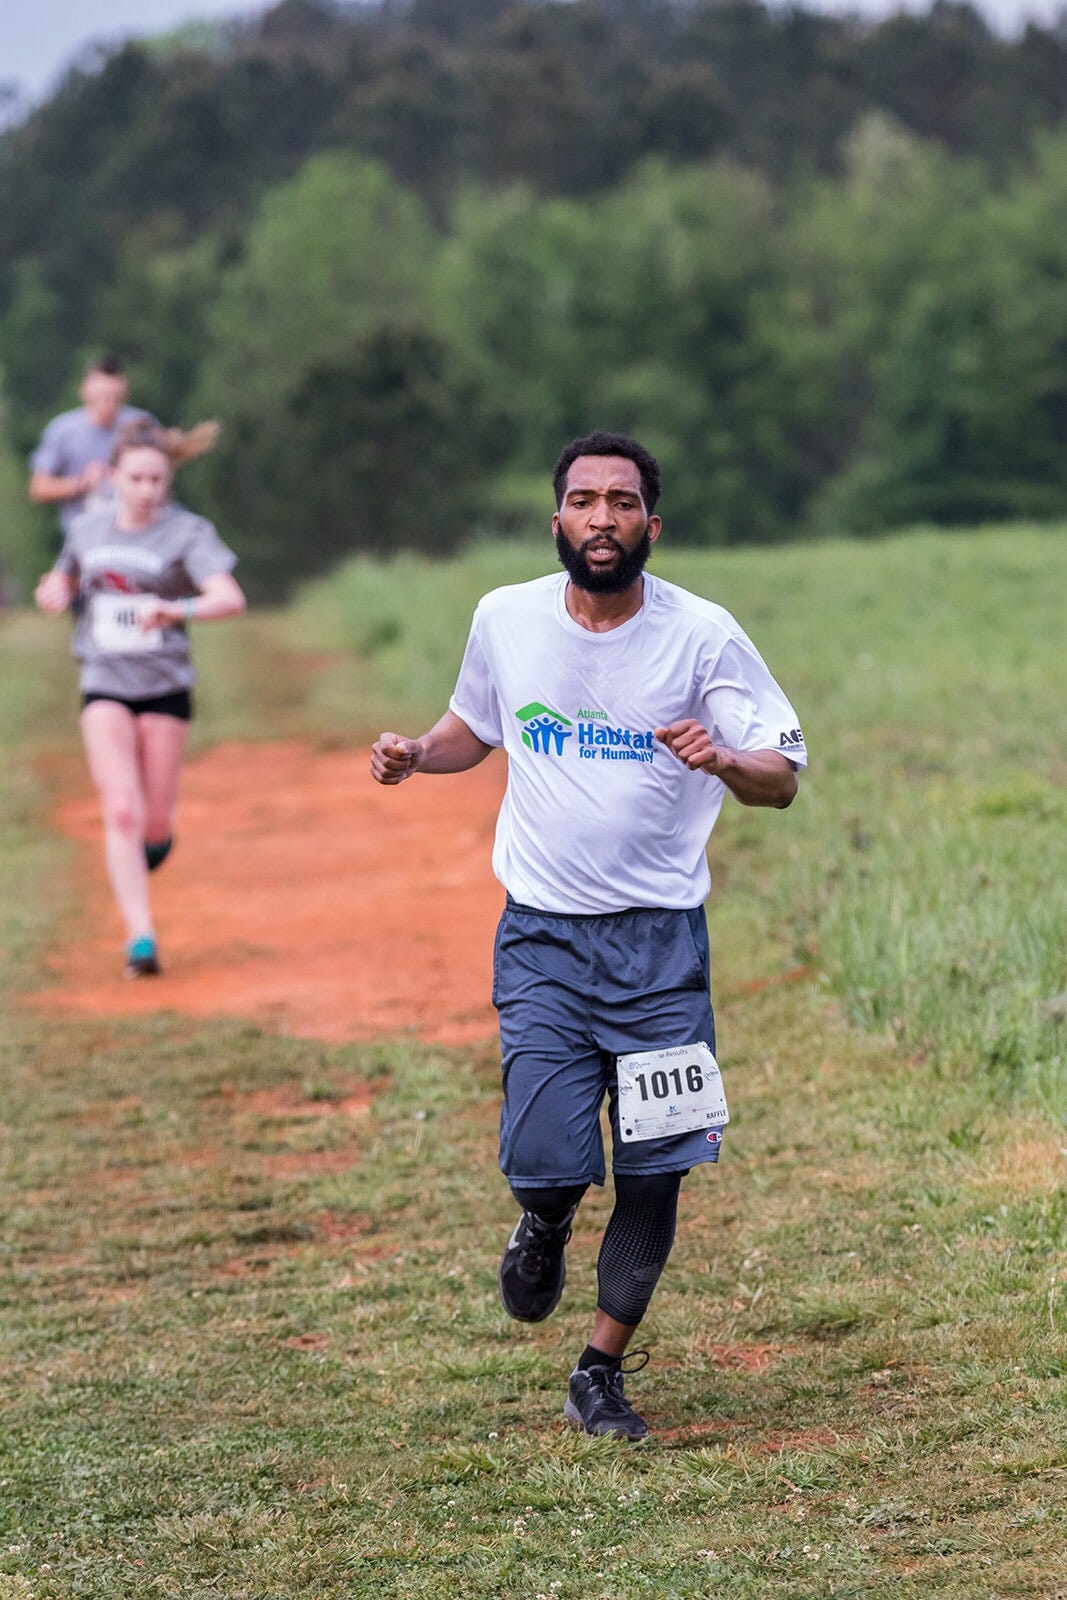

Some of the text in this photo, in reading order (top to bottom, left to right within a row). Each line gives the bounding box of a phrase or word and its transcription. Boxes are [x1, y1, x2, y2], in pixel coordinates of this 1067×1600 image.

[577, 708, 608, 720] Atlanta
[578, 723, 654, 749] Habitat
[579, 746, 654, 764] for Humanity
[635, 1064, 704, 1101] 1016
[706, 1109, 726, 1119] RAFFLE
